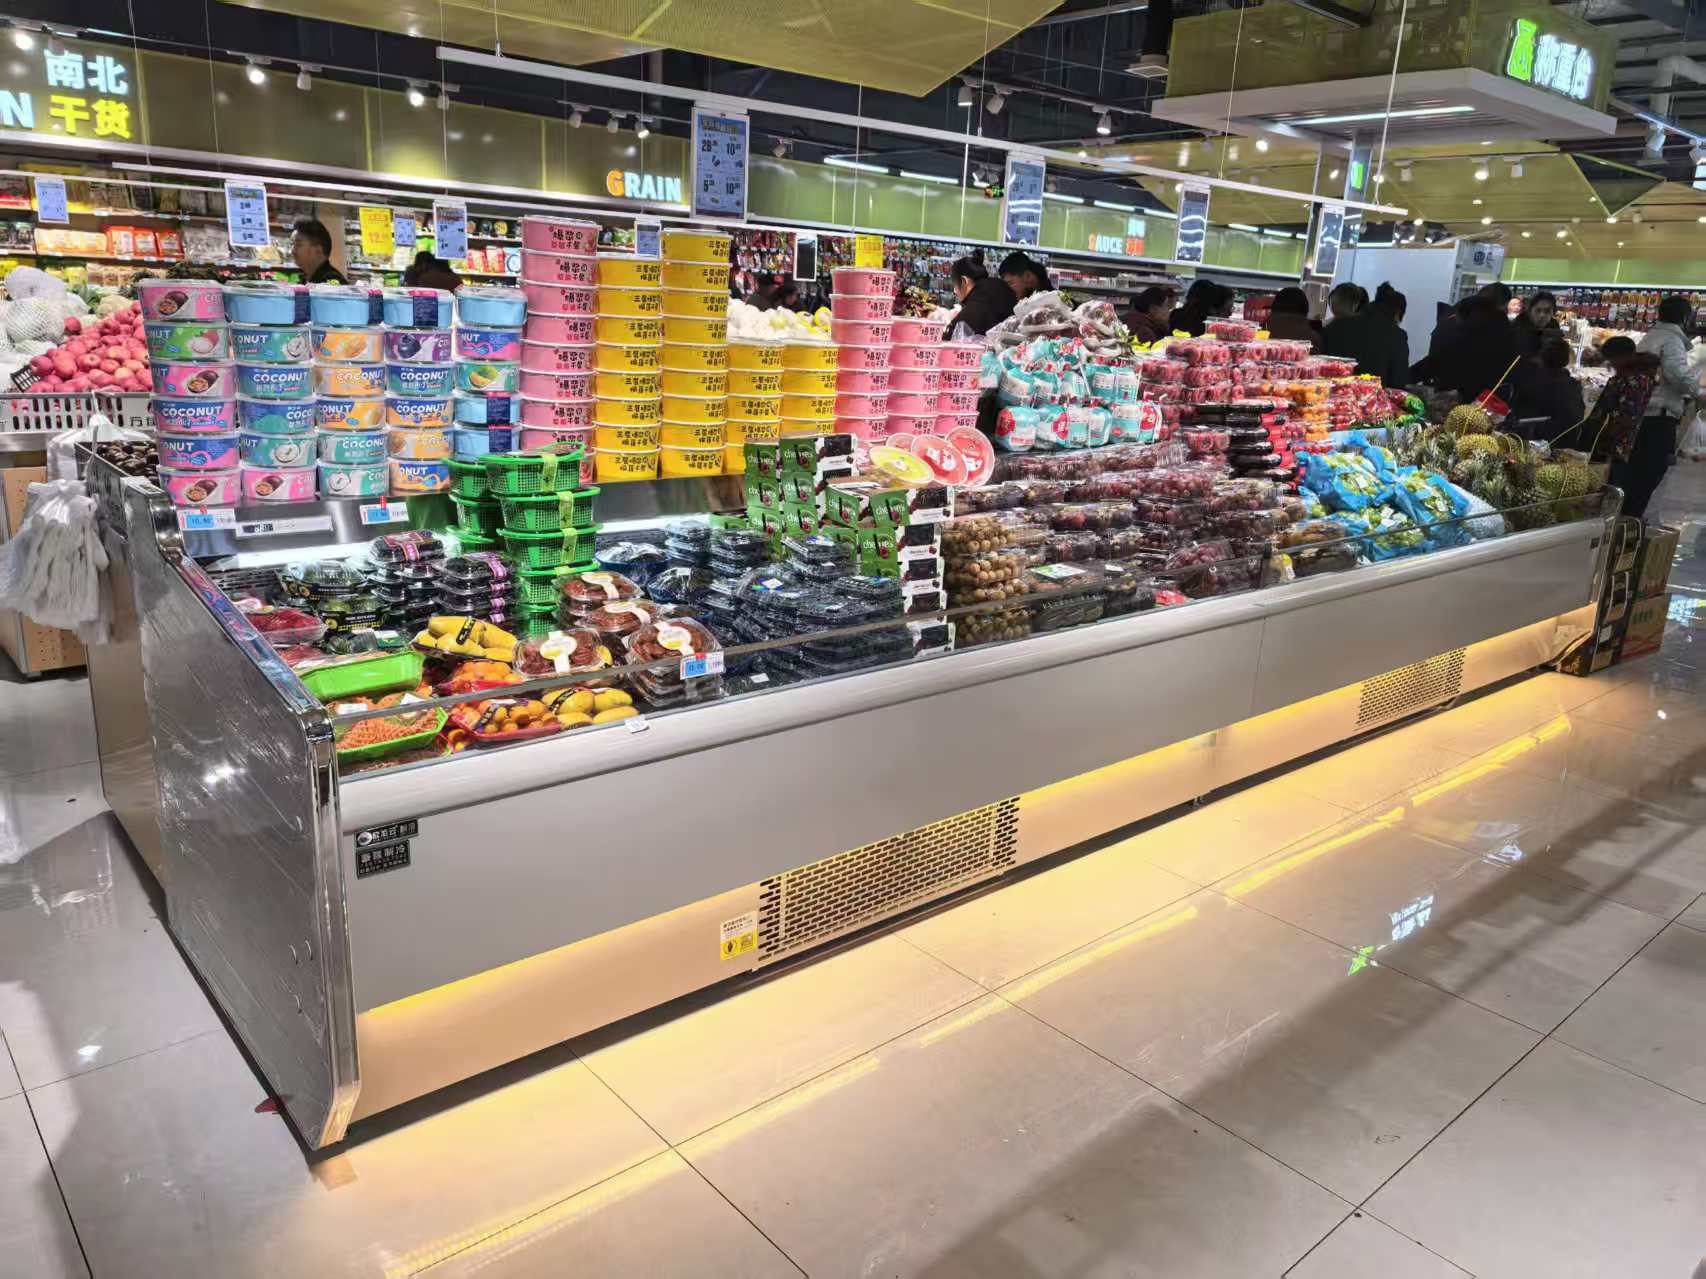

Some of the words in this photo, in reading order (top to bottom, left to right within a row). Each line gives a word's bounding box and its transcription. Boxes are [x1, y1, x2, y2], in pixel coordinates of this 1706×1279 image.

[43, 48, 129, 95] 南北
[49, 94, 131, 139] 干货
[606, 169, 681, 202] GRAIN
[253, 371, 308, 382] COCONUT
[400, 370, 448, 381] COCONUT
[162, 405, 222, 417] COCONUT
[396, 402, 444, 414] COCONUT
